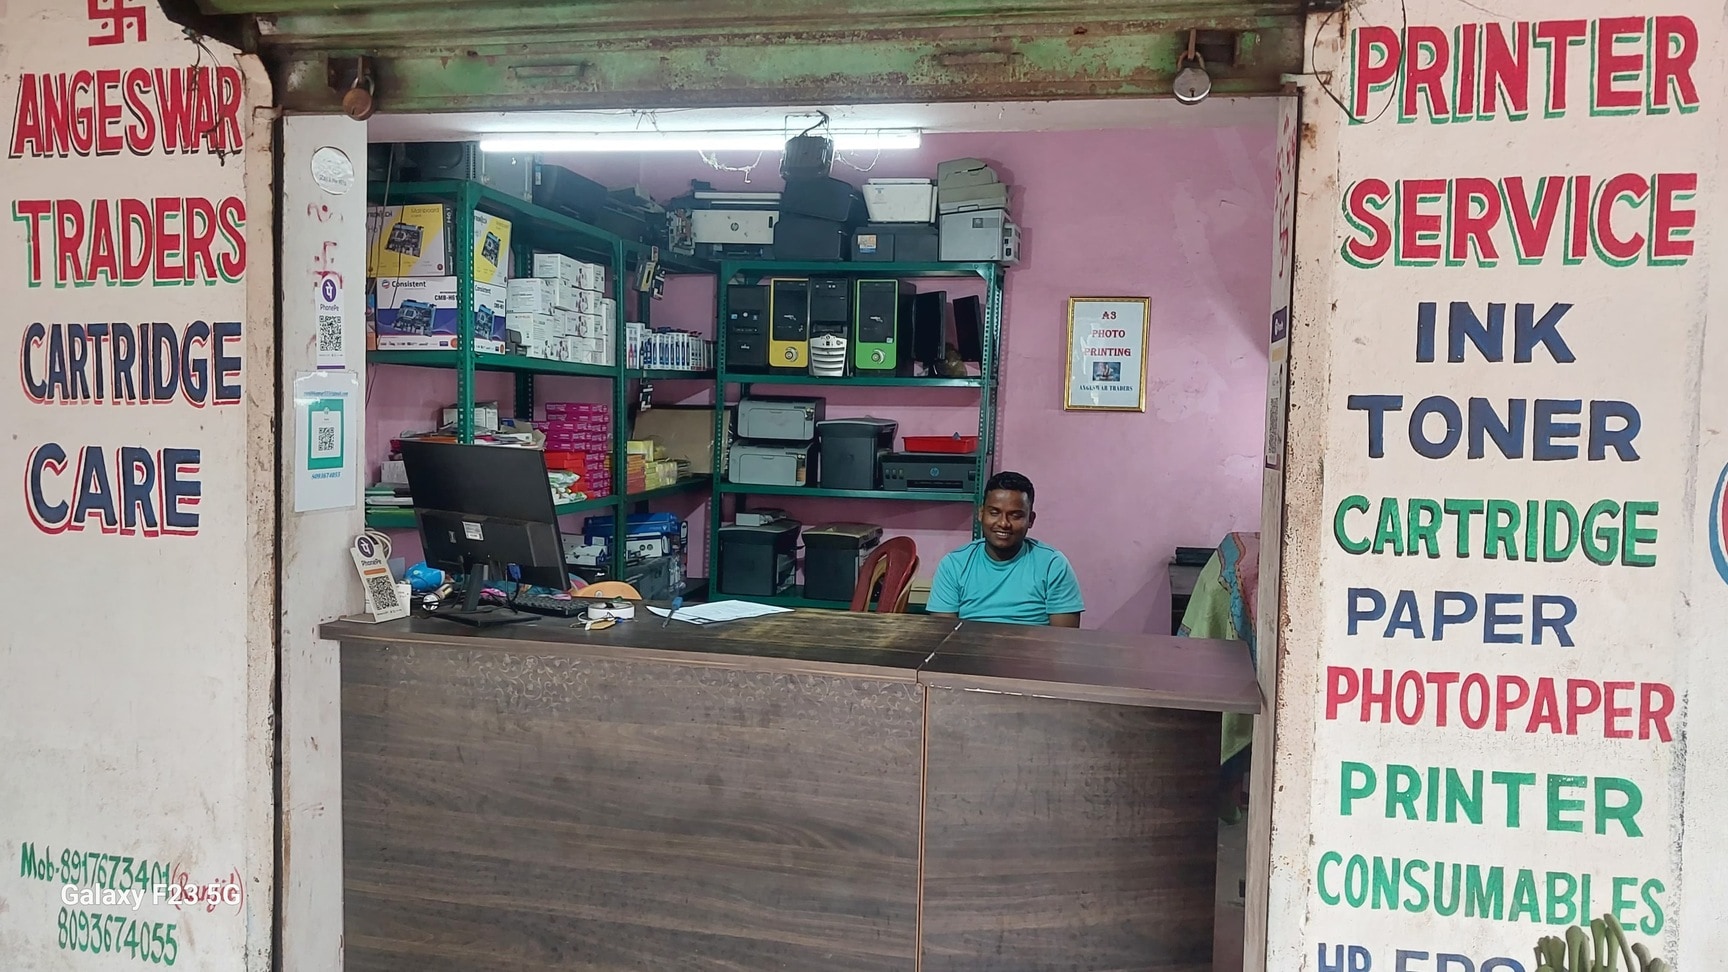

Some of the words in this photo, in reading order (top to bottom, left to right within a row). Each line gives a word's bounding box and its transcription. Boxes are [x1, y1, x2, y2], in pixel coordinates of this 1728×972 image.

[1348, 16, 1700, 126] PRINTER
[8, 66, 244, 159] ANGESWAR
[12, 196, 247, 288] TRADERS
[1341, 173, 1698, 268] SERVICE
[320, 303, 339, 312] PhonePe
[1092, 330, 1126, 338] PHOTO
[1102, 311, 1117, 320] A3
[1415, 301, 1576, 363] INK
[19, 320, 243, 409] CARTRIDGE
[1085, 348, 1131, 356] PRINTING
[1347, 395, 1641, 462] TONER
[24, 442, 202, 538] CARE
[1333, 495, 1659, 567] CARTRIDGE
[1346, 587, 1578, 648] PAPER
[1325, 665, 1676, 743] PHOTOPAPER
[1339, 760, 1644, 838] PRINTER
[1316, 850, 1666, 937] CONSUMABLES
[57, 906, 179, 966] 8093674055
